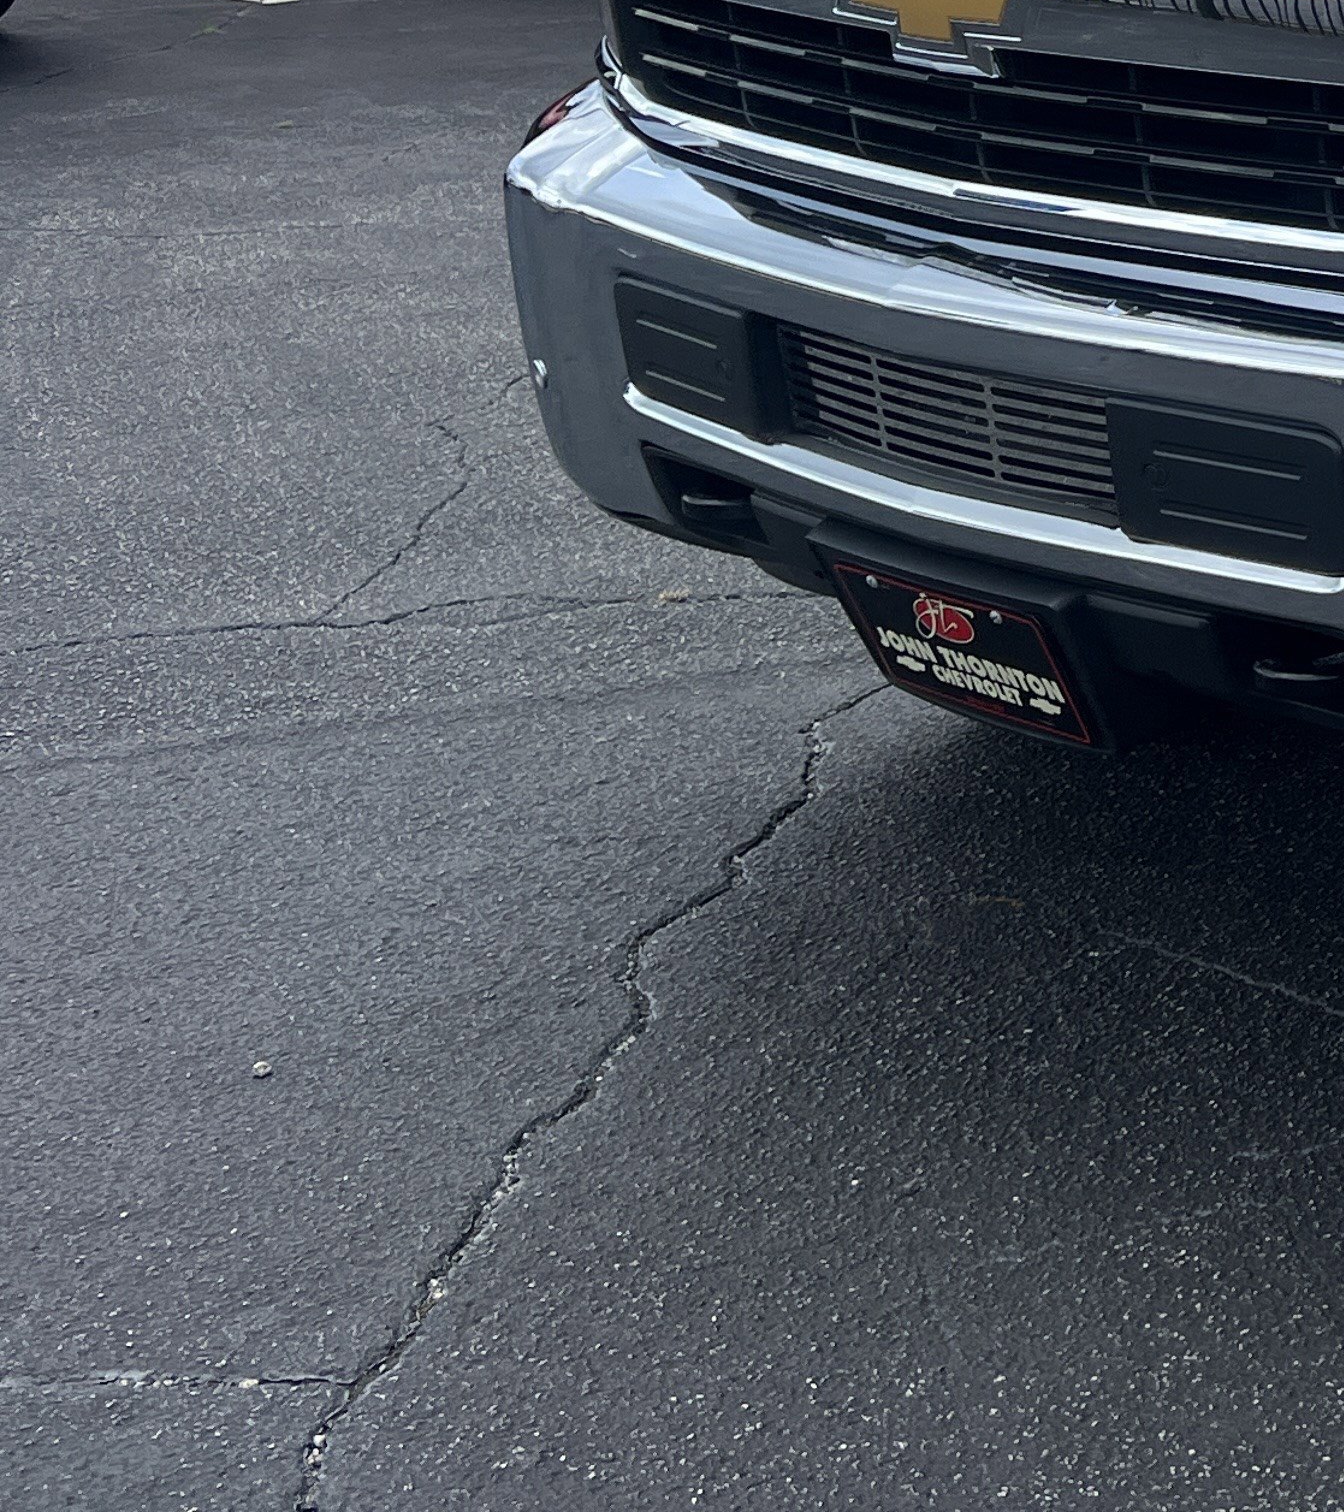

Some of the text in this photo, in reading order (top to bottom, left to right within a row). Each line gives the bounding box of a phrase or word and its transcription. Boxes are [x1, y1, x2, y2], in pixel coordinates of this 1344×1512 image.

[877, 626, 1065, 704] JOHN THORNTON
[933, 664, 1023, 707] CHEVROLET
